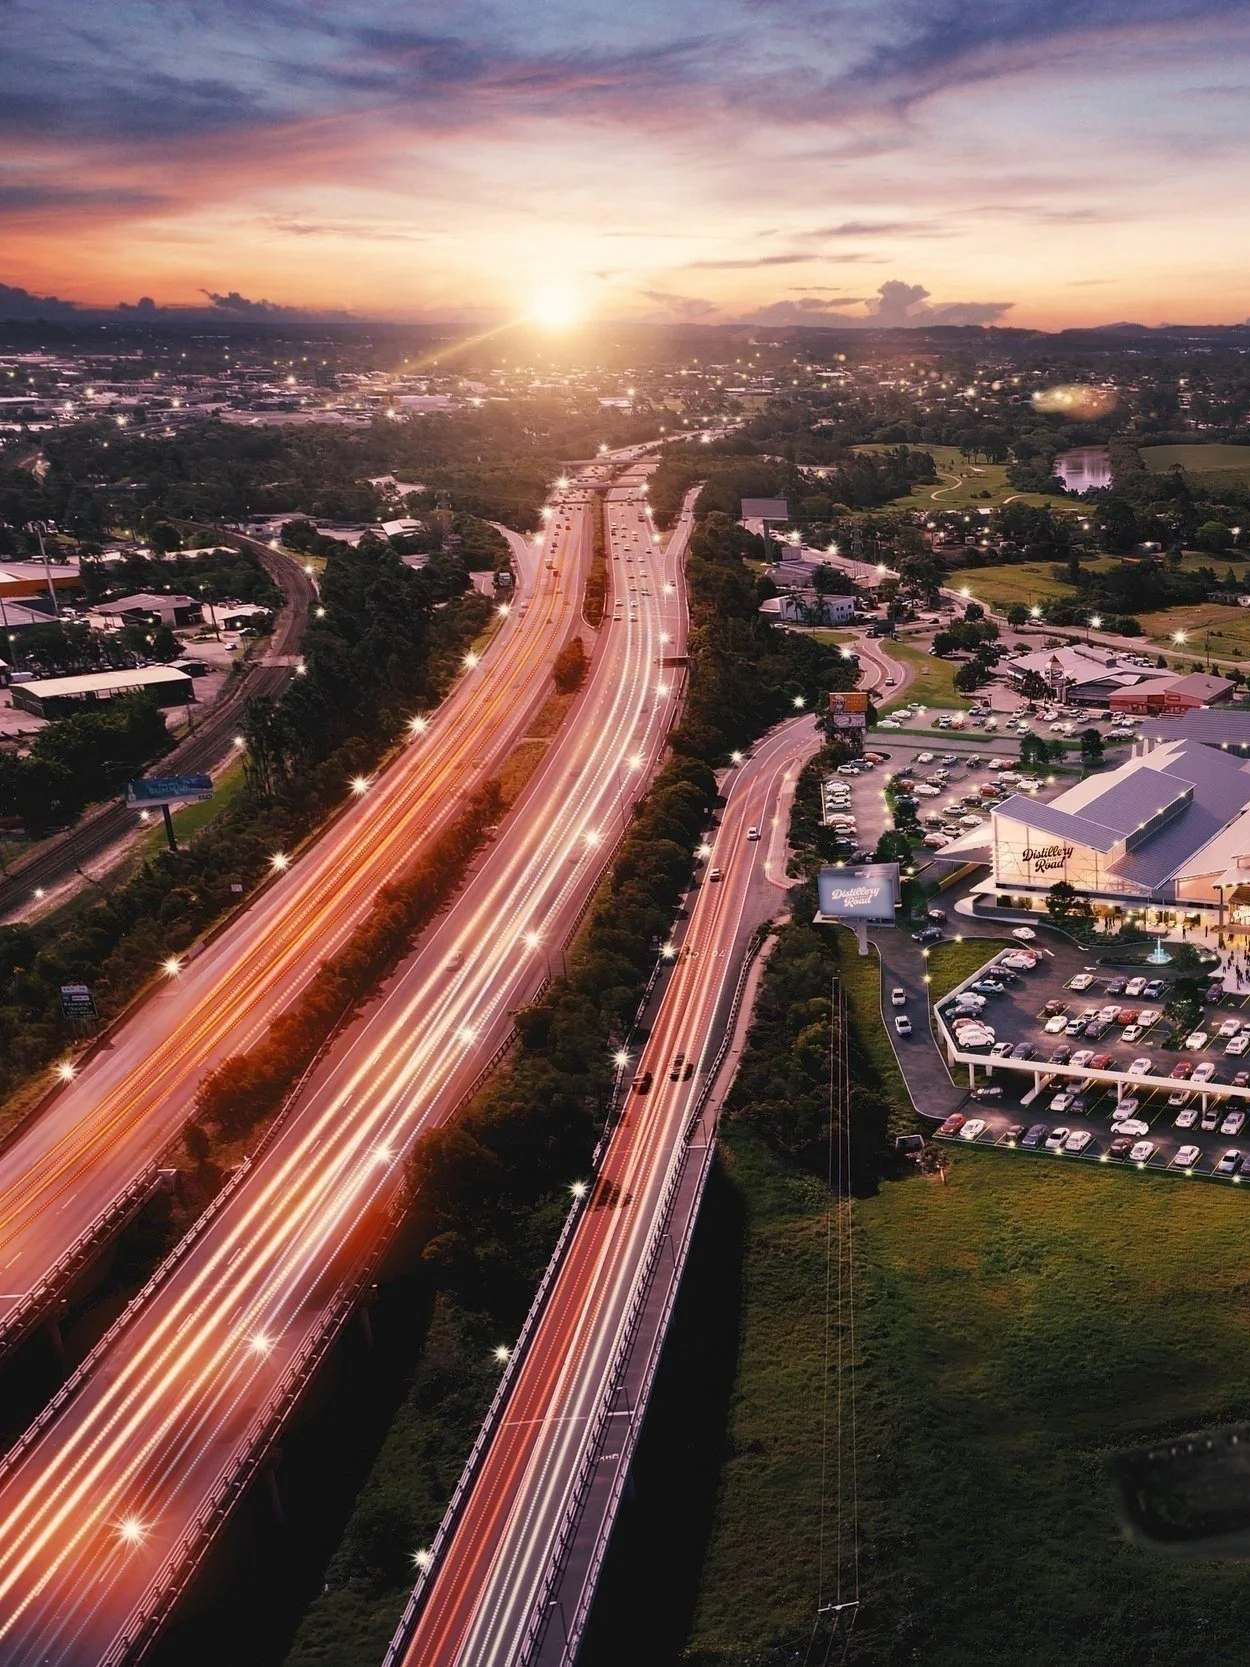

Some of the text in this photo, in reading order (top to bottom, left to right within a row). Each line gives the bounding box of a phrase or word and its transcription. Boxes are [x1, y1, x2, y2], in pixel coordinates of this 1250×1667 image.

[1022, 845, 1074, 862] Distillery
[1034, 857, 1066, 873] Road
[831, 886, 880, 900] Distillery
[843, 895, 873, 908] Road
